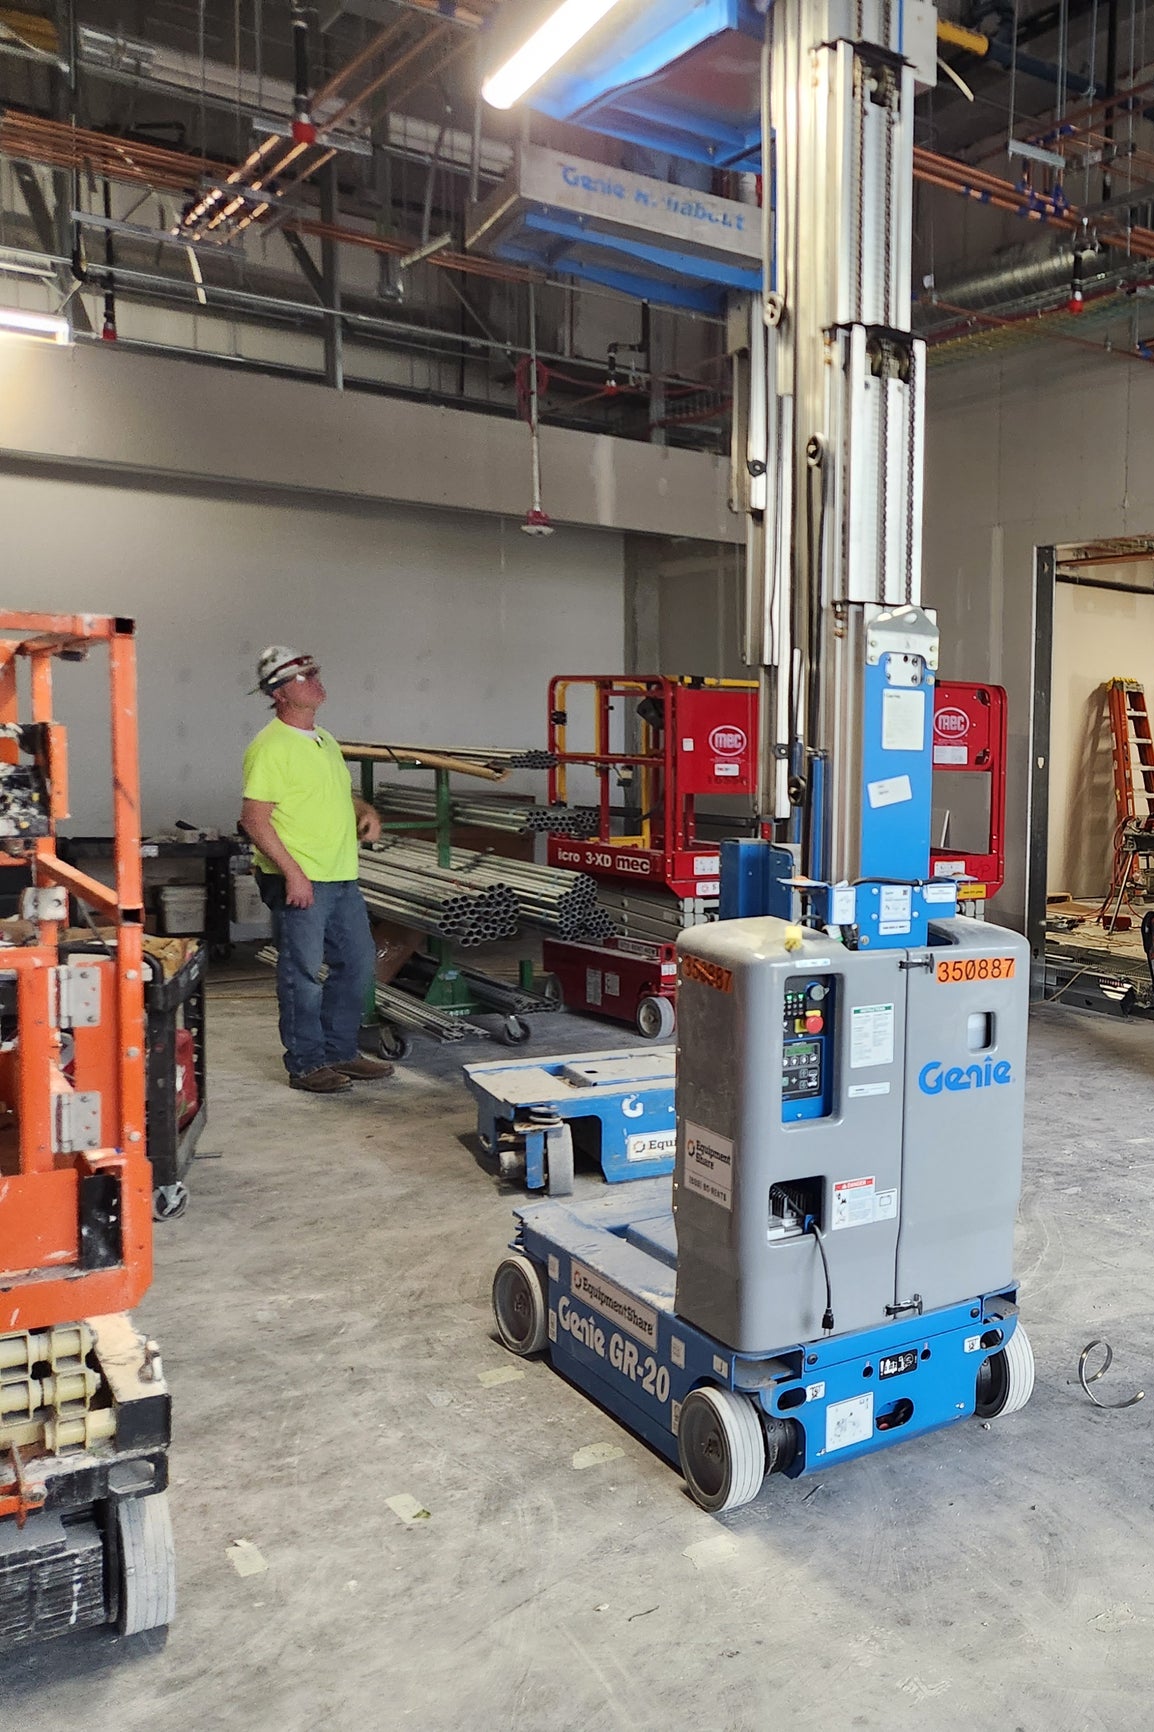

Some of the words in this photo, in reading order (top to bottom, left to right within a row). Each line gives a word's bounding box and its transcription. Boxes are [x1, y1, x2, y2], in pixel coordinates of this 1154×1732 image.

[714, 733, 742, 749] mec
[616, 856, 650, 874] mec
[937, 958, 1015, 983] 350887
[918, 1055, 1012, 1095] Genie
[696, 1140, 731, 1165] Equipment
[583, 1277, 653, 1336] EquipmentShare
[558, 1295, 606, 1358] Genie
[609, 1332, 670, 1403] GR-20
